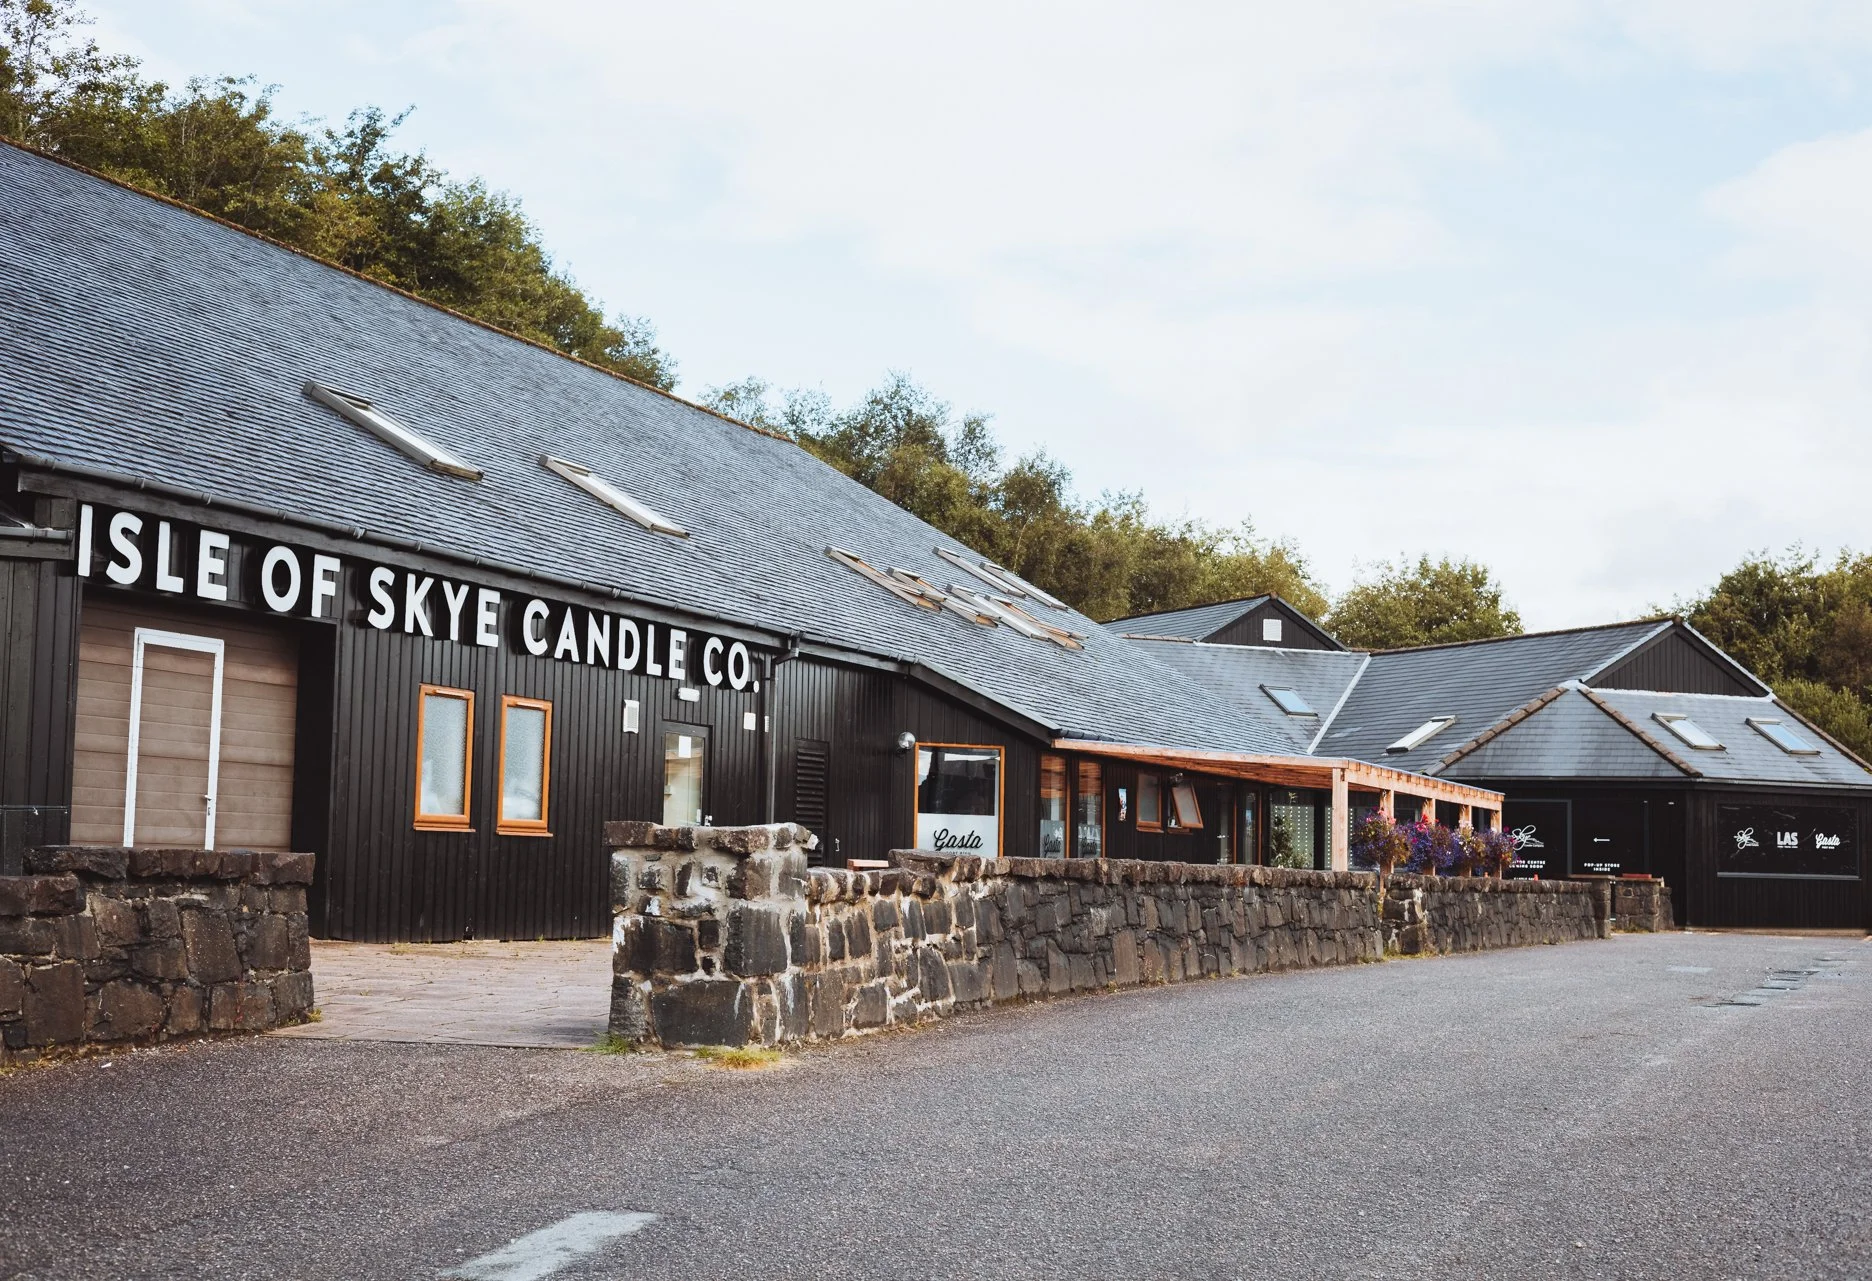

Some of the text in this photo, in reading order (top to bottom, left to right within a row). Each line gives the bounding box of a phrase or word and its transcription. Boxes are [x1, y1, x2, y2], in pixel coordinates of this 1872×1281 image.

[78, 504, 760, 694] ISLE OF SKYE CANDLE CO.
[933, 828, 984, 851] Gasta
[1776, 831, 1799, 846] LAS
[1815, 832, 1841, 849] Gasta
